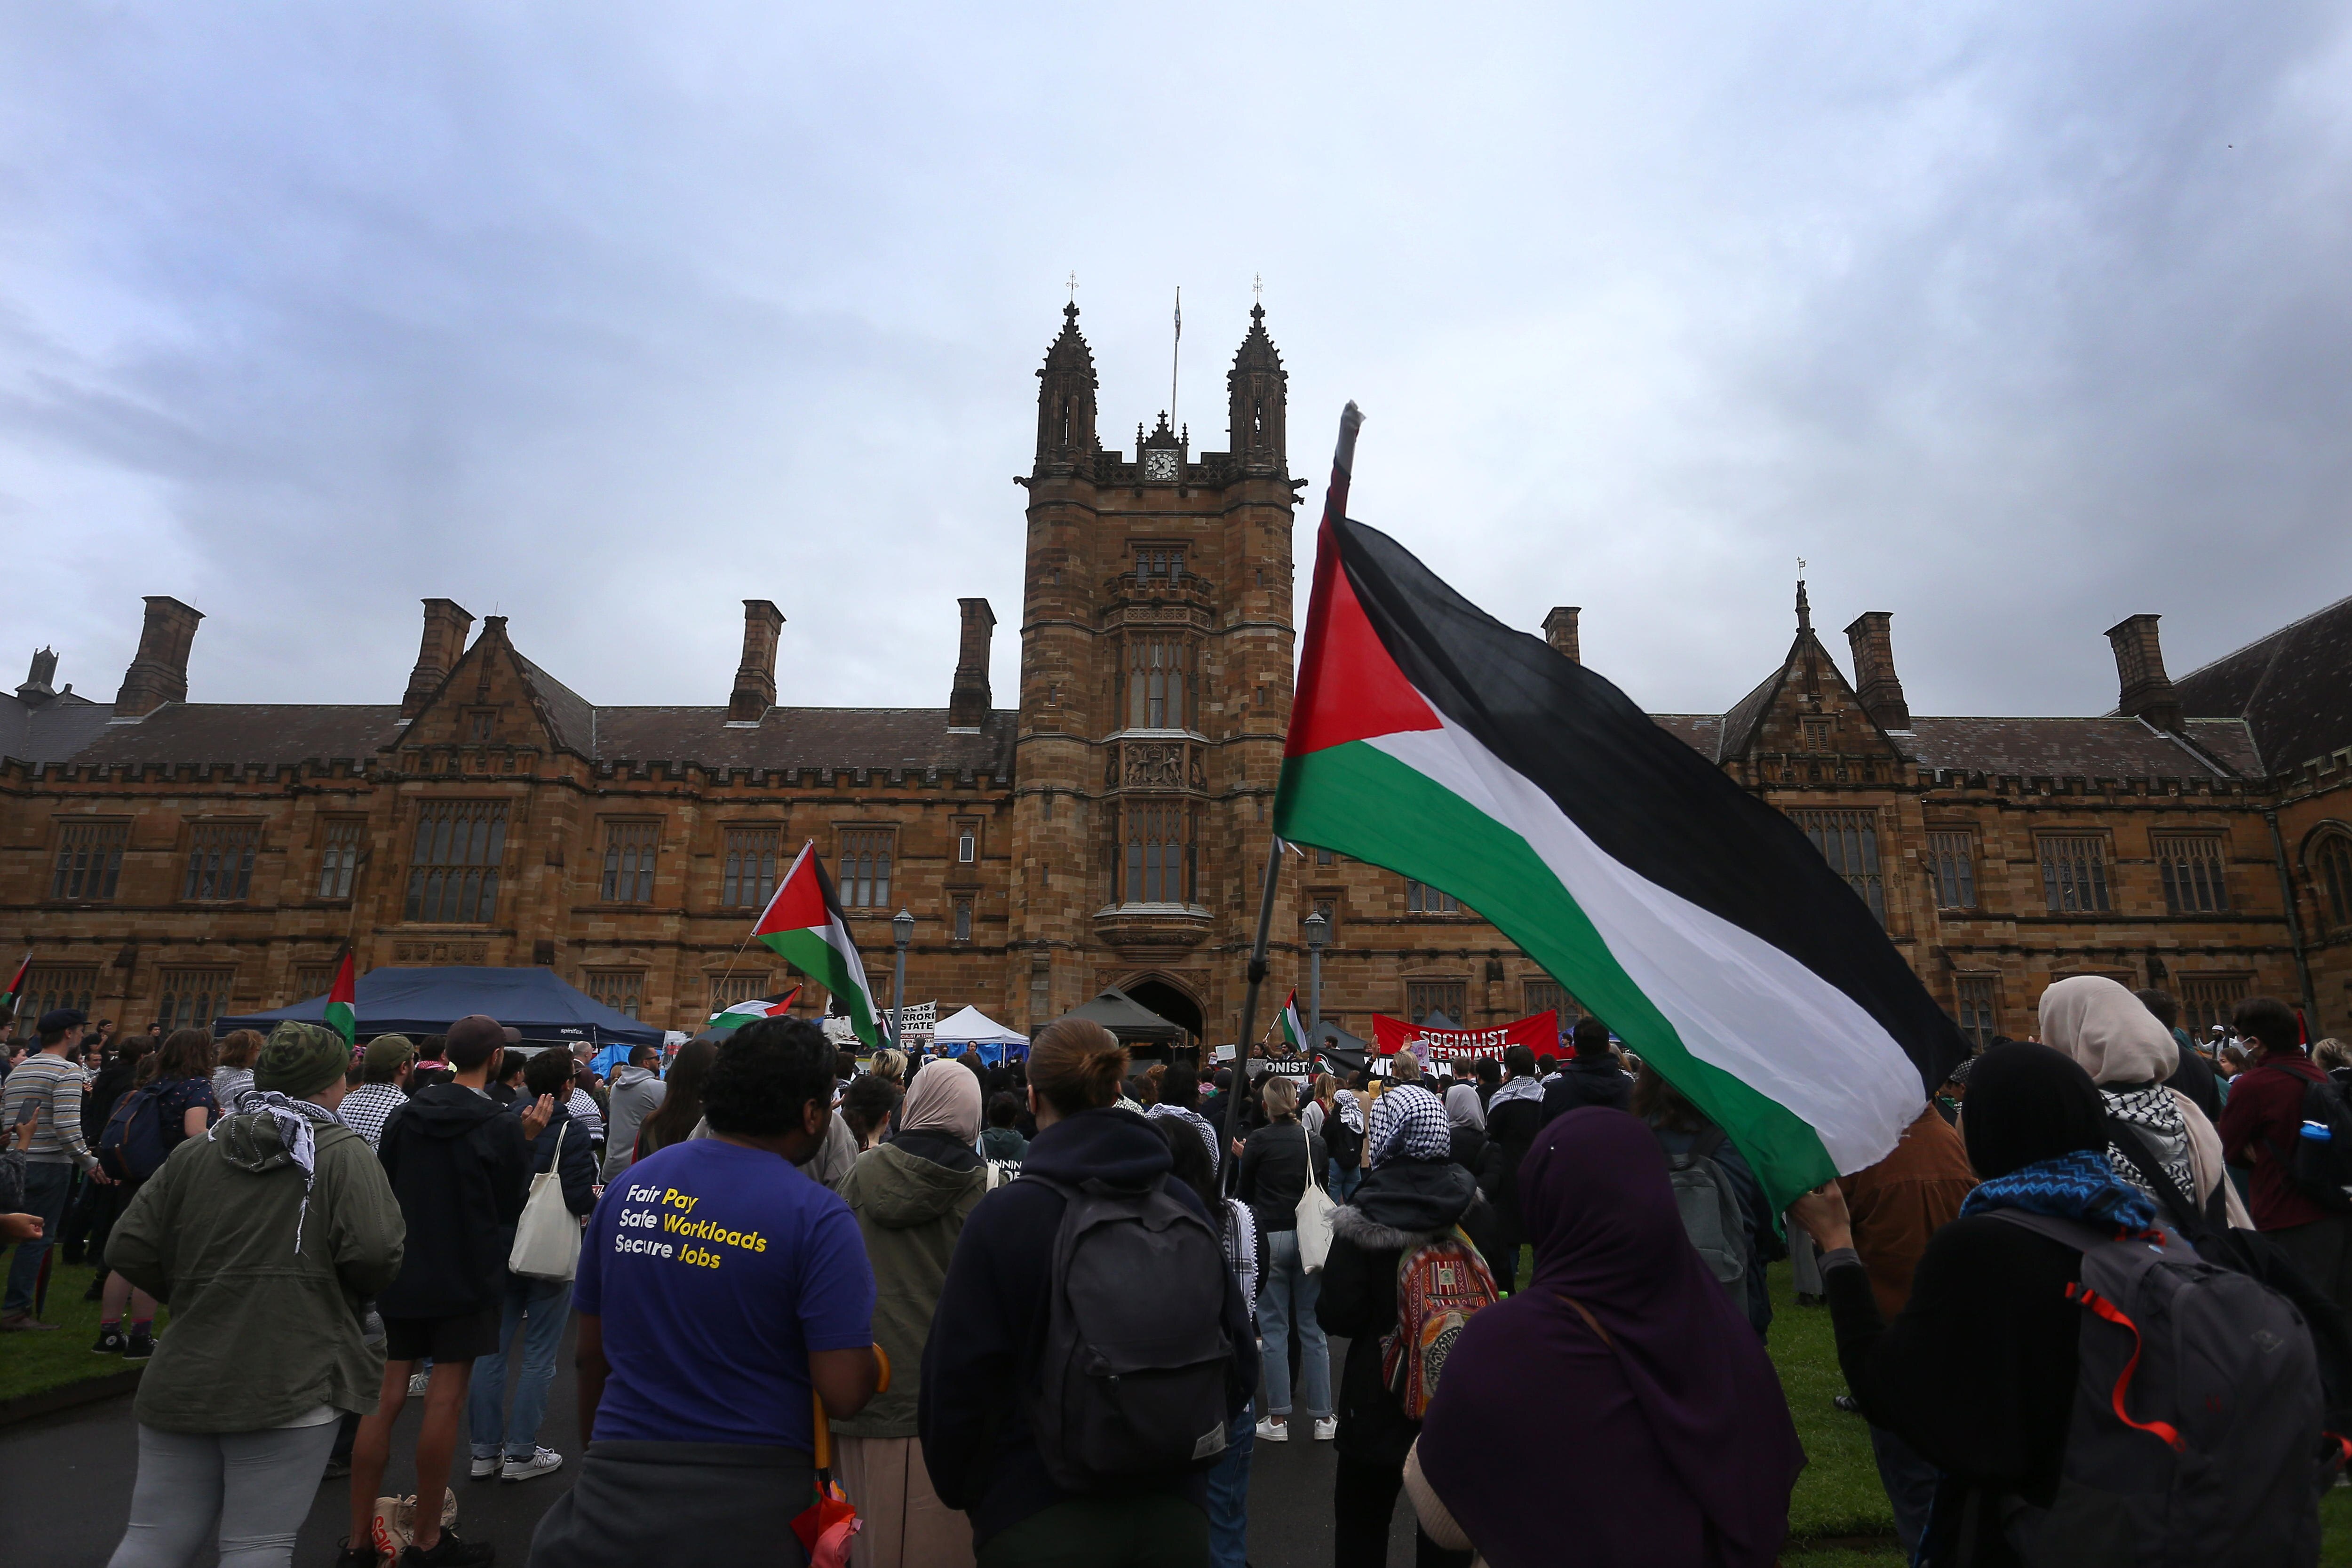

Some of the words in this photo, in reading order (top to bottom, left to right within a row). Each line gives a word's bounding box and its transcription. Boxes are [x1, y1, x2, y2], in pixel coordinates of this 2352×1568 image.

[901, 1022, 933, 1030] STATE
[1419, 1029, 1509, 1047] SOCIALIST
[1265, 1062, 1310, 1073] ONIST
[626, 1185, 661, 1202] Fair
[661, 1188, 699, 1214] Pay
[619, 1209, 657, 1228] Safe
[664, 1213, 767, 1252] Workloads
[615, 1234, 673, 1258] Secure
[677, 1244, 721, 1269] Jobs
